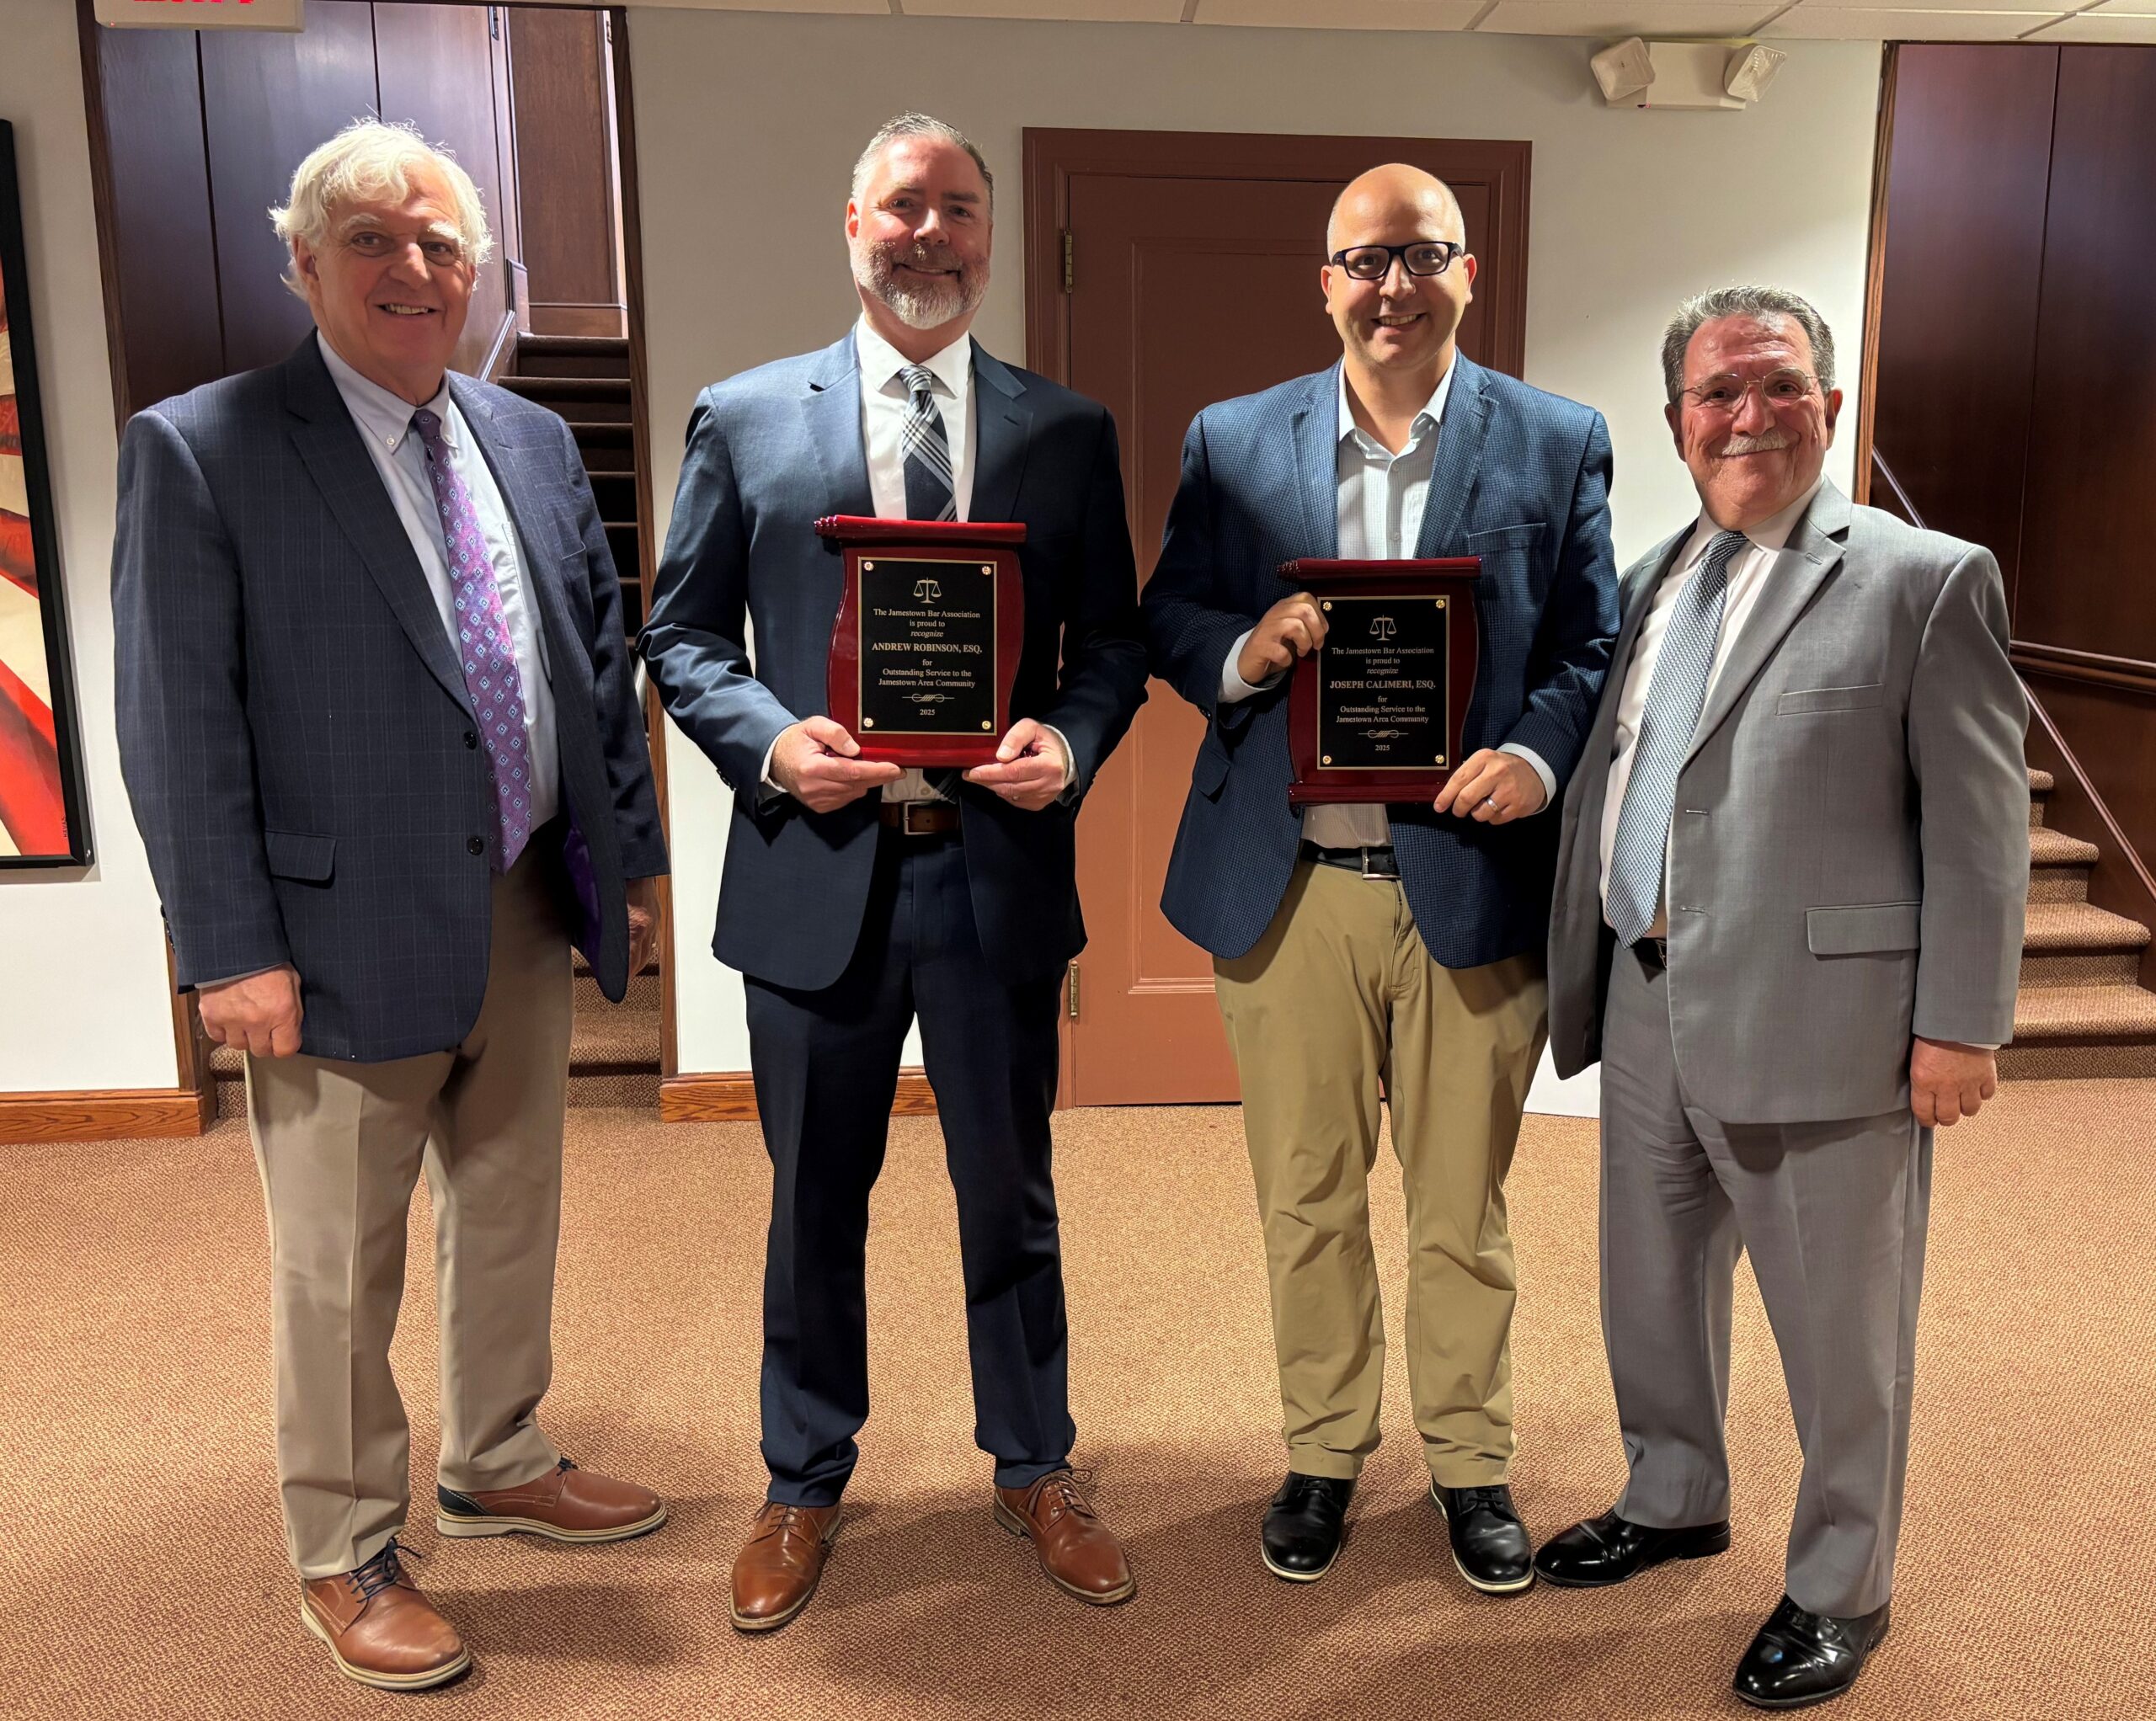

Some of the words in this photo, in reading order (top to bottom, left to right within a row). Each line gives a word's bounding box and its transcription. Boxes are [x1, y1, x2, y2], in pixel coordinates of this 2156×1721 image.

[873, 608, 887, 616] The
[888, 608, 926, 617] Jamestown
[928, 610, 940, 618] Bar
[916, 620, 937, 628] proud
[910, 630, 943, 638] recognize
[913, 643, 962, 653] ROBINSON,
[963, 645, 982, 653] ESQ.
[883, 669, 924, 677] Outstanding
[878, 679, 916, 687] Jamestown
[936, 679, 975, 688] Community
[1366, 680, 1414, 690] CALIMERI,
[1417, 680, 1436, 690] ESQ.
[1340, 706, 1379, 714] Outstanding
[1390, 716, 1428, 724] Community
